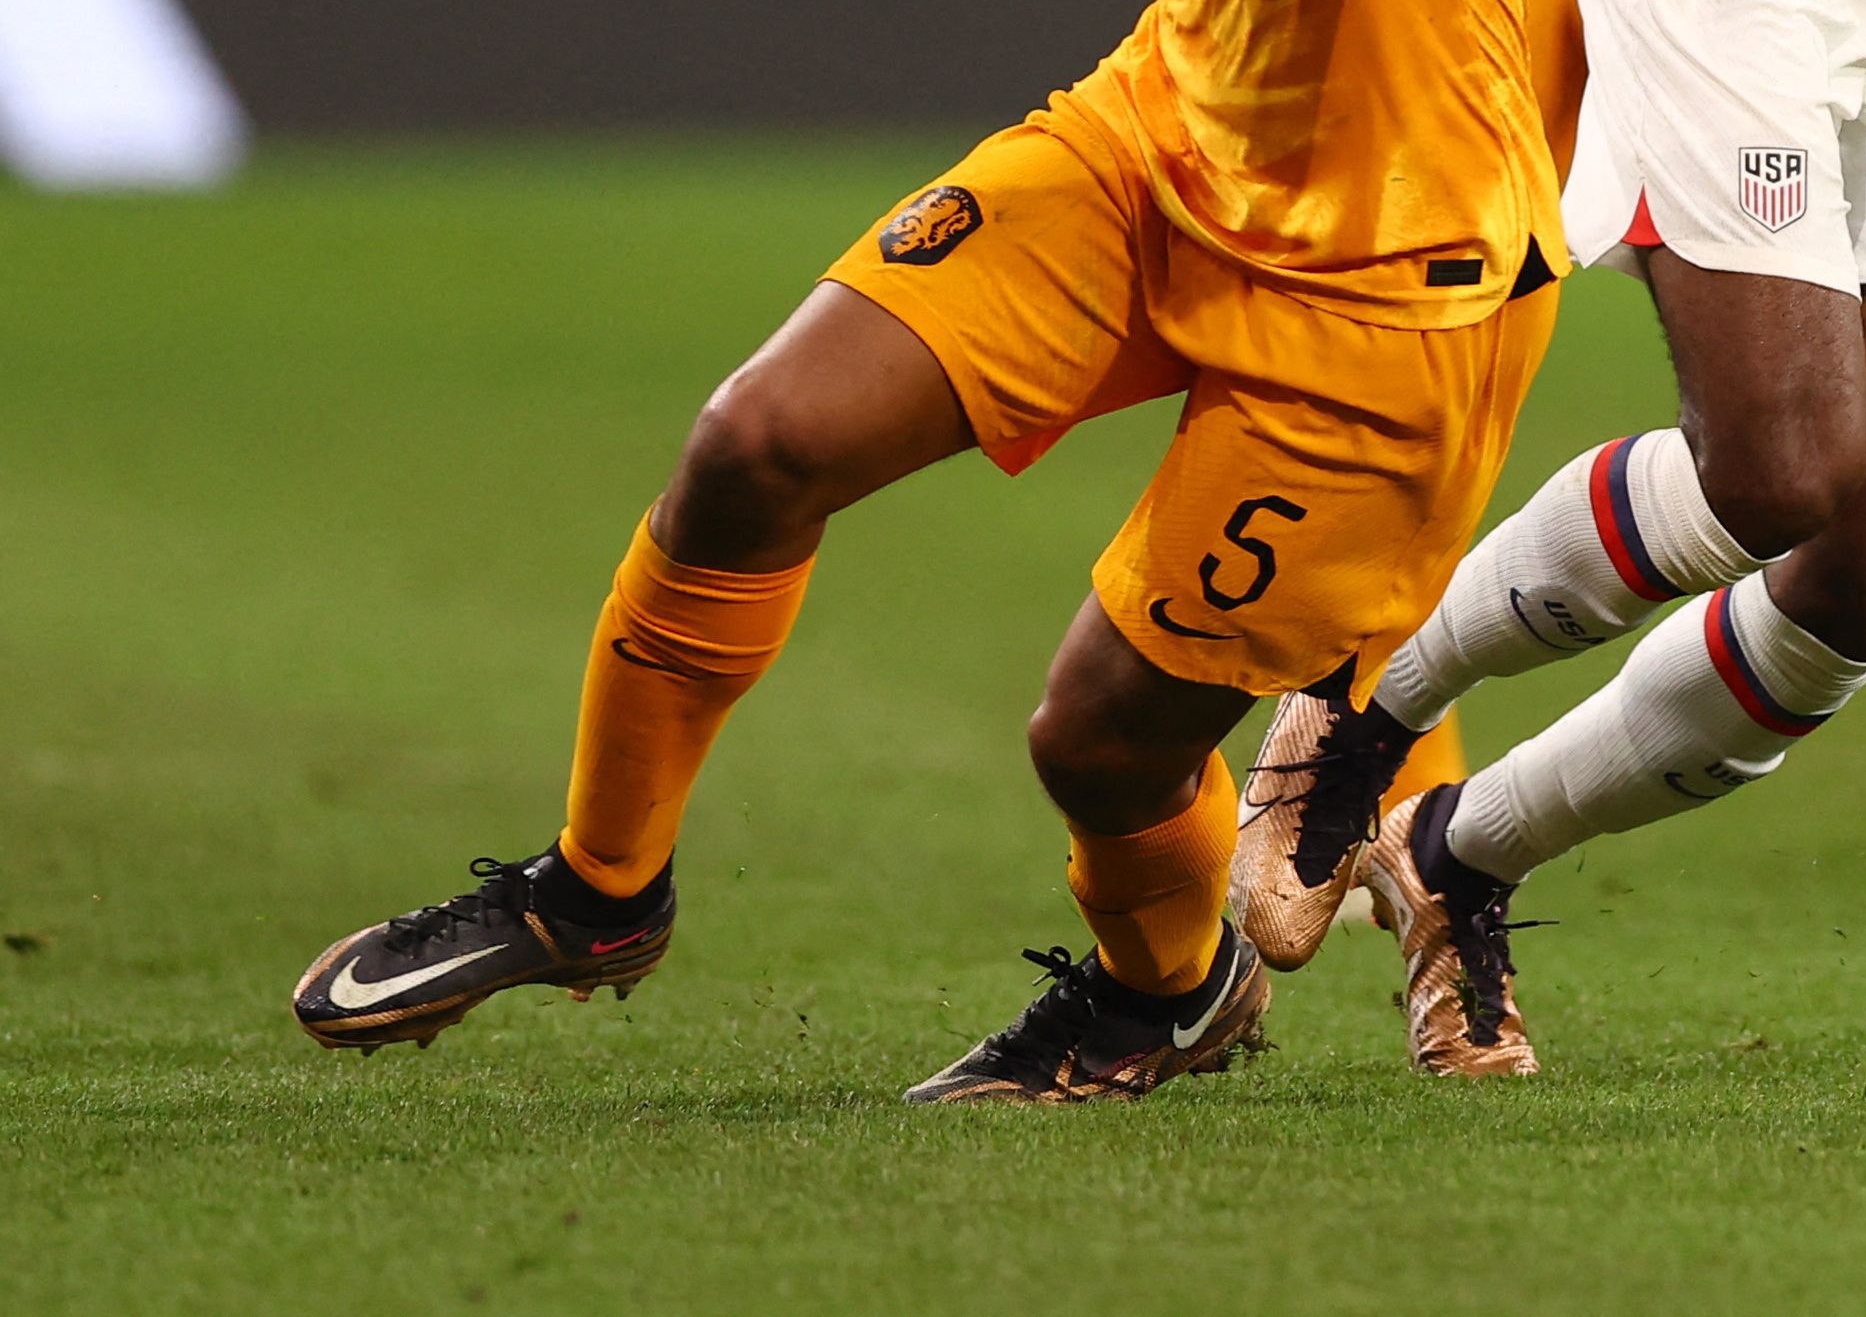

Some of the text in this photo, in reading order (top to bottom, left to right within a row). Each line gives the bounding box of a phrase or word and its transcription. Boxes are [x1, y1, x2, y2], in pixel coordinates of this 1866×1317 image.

[1745, 153, 1802, 184] USA
[1198, 495, 1308, 611] 5
[1544, 600, 1606, 645] USA
[1705, 762, 1749, 786] US
